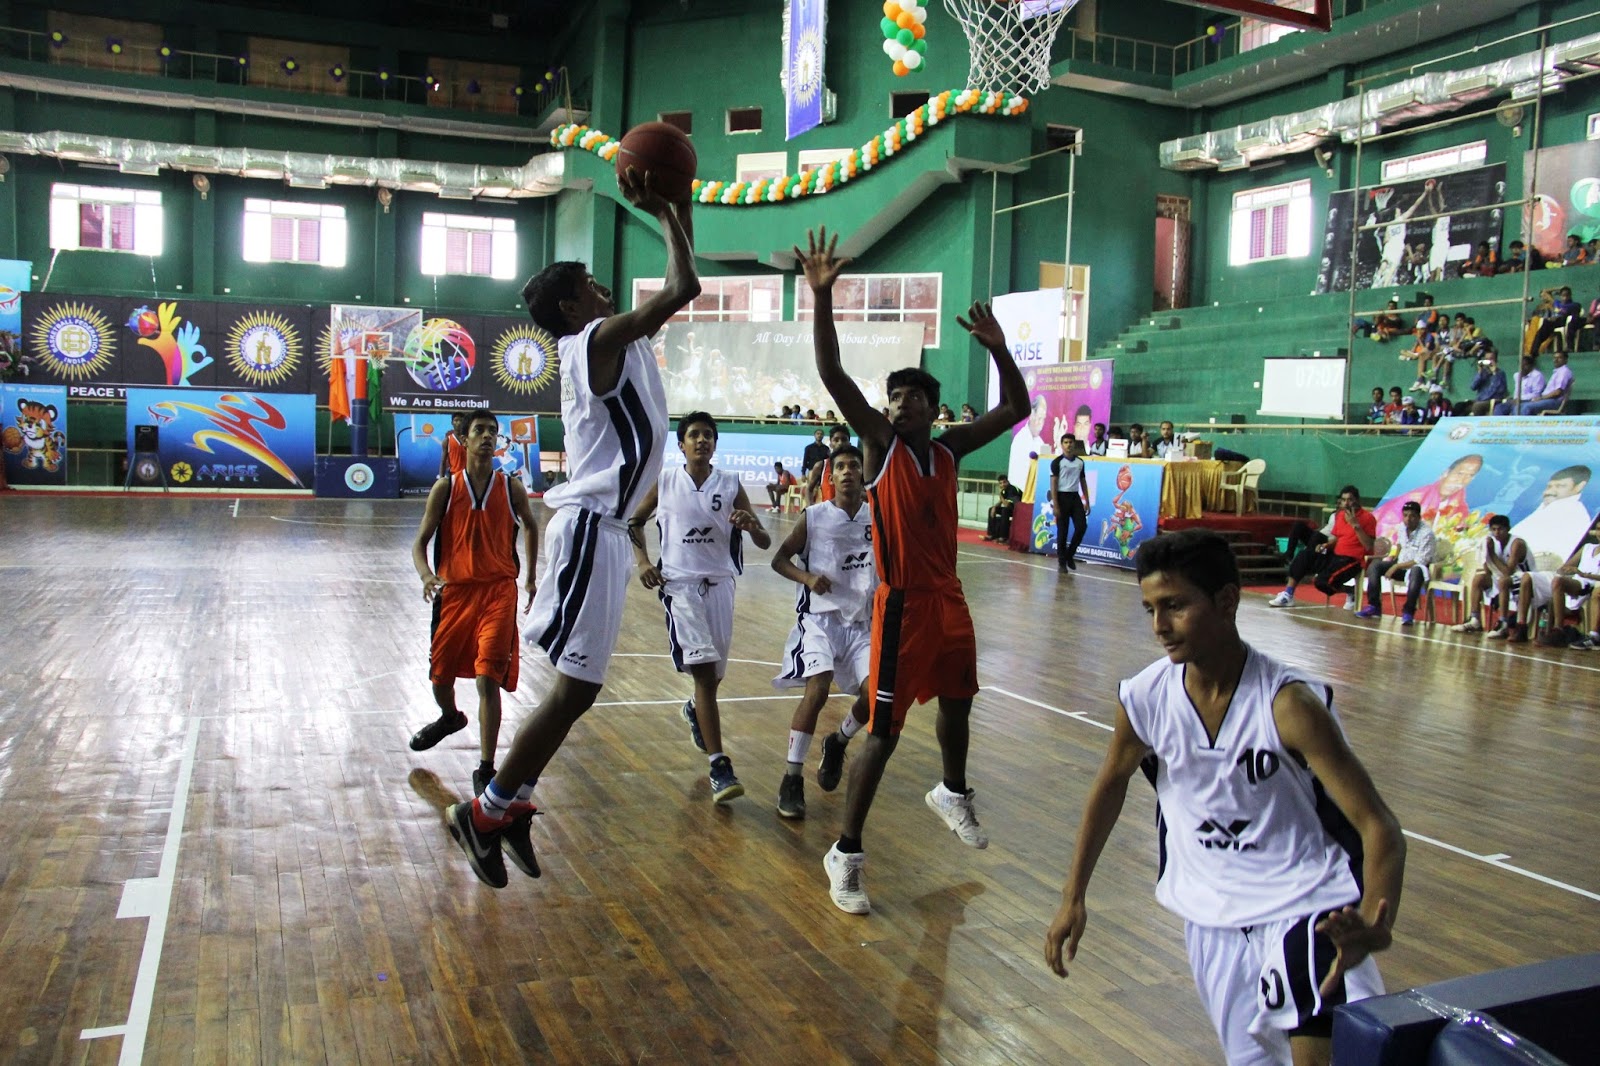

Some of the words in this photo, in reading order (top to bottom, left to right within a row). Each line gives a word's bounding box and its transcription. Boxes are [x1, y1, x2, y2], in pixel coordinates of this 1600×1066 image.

[752, 332, 770, 344] All
[773, 333, 793, 346] Day
[869, 333, 901, 346] Sports
[63, 357, 87, 365] INDIA
[70, 386, 115, 398] PEACE
[390, 396, 408, 406] We
[412, 397, 432, 407] Are
[434, 398, 490, 409] Basketball
[723, 454, 804, 468] THROUGH
[197, 464, 259, 476] ARISE
[711, 494, 722, 512] 5
[864, 524, 872, 542] 8
[1076, 546, 1091, 554] OUGH
[1090, 548, 1122, 560] BASKETBALL
[841, 561, 872, 571] NIVIA
[1236, 747, 1280, 785] 10
